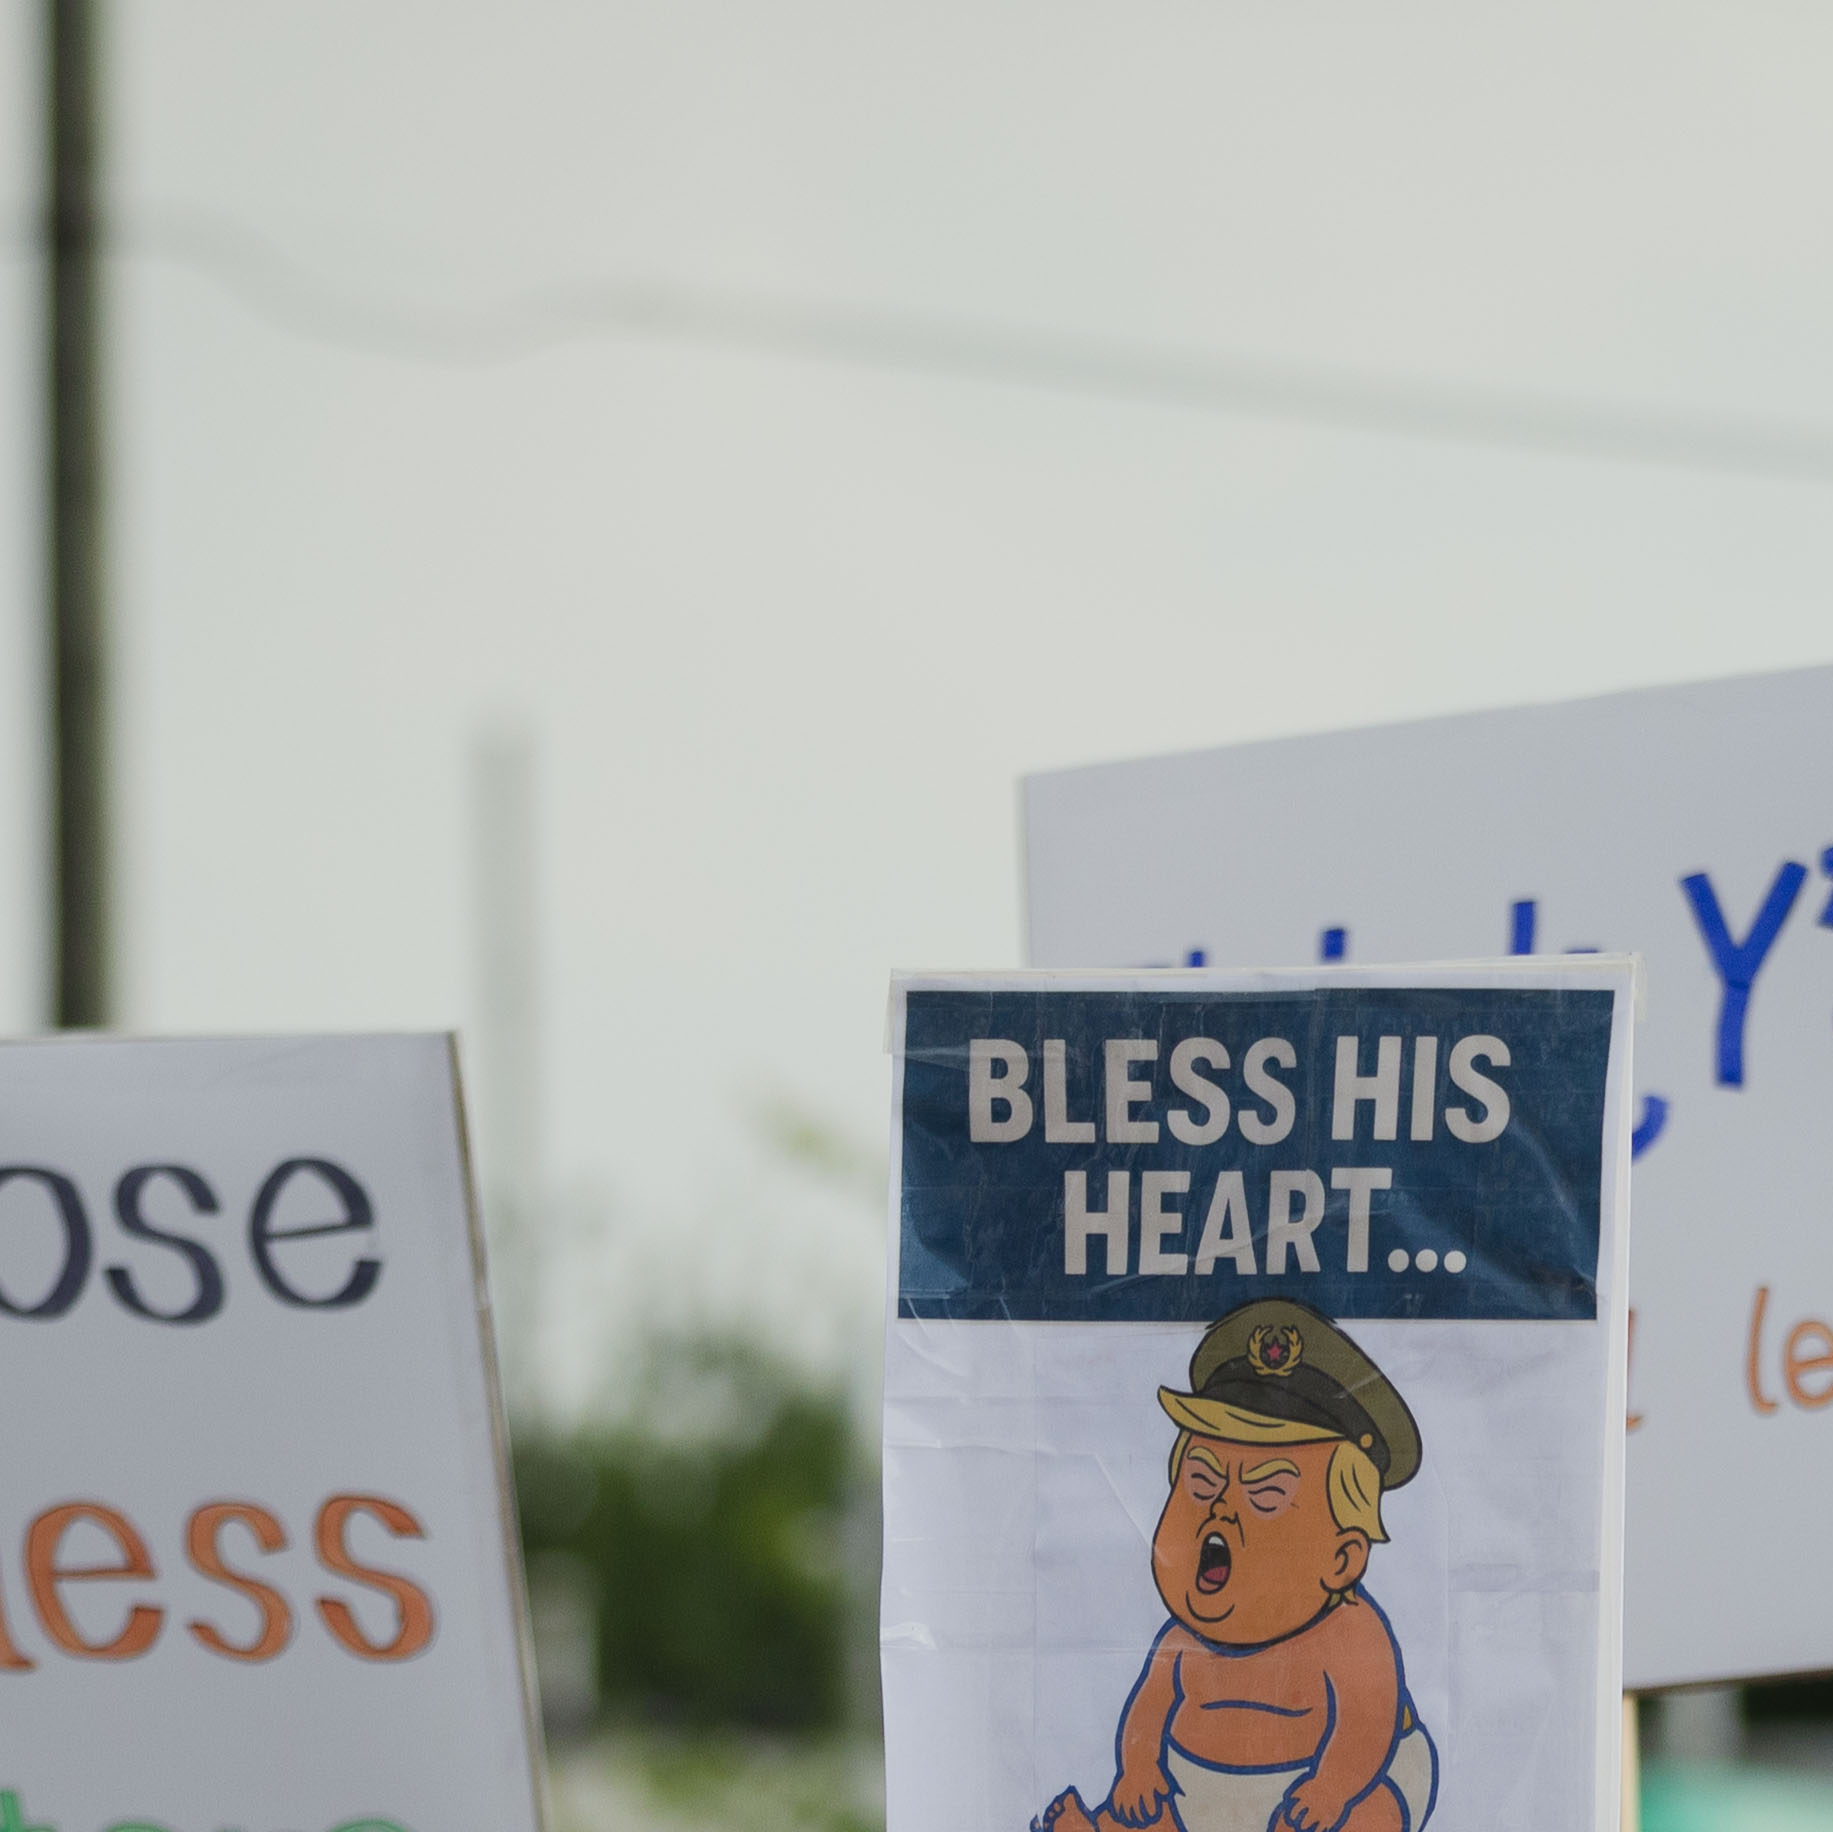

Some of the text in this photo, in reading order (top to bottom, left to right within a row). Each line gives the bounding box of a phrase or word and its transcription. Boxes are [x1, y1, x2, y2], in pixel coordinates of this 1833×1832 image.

[967, 1035, 1297, 1147] BLESS
[1331, 1033, 1513, 1144] HIS
[1063, 1166, 1469, 1279] HEART...
